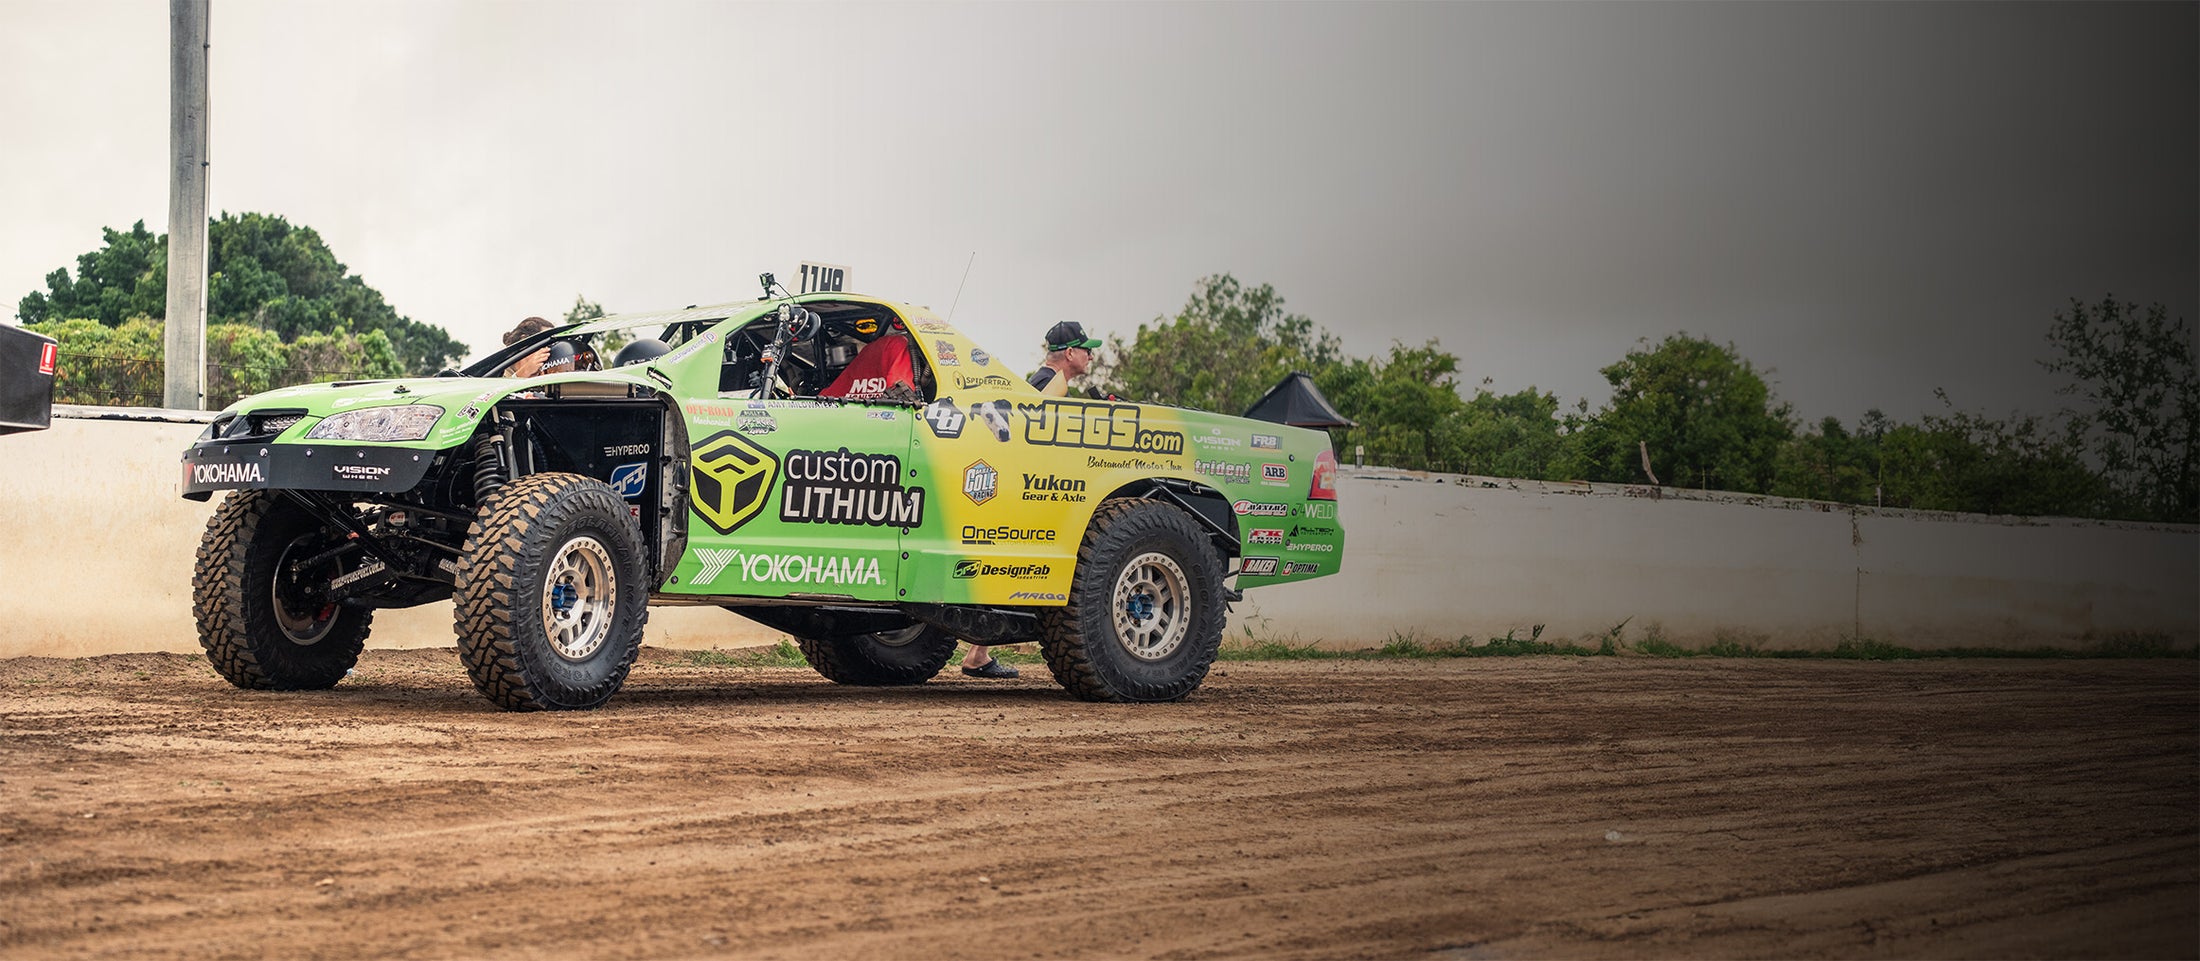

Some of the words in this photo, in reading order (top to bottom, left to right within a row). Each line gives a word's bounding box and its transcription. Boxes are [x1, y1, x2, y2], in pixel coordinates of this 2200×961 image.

[850, 378, 887, 393] MSD
[966, 376, 1012, 387] SPIDERTRAX
[686, 404, 734, 417] OFF-ROAD
[1019, 401, 1183, 454] JEGS.com
[1193, 435, 1241, 447] VISION
[611, 444, 650, 456] HYPERCO
[334, 465, 391, 475] VISION
[787, 452, 897, 484] custom
[1132, 459, 1164, 471] Motor
[1166, 459, 1182, 471] Inn
[1195, 459, 1251, 477] trident
[193, 463, 262, 483] YOKOHAMA
[1265, 467, 1286, 478] ARB
[964, 469, 997, 492] COLE
[1022, 474, 1086, 492] Yukon
[1022, 492, 1049, 501] Gear
[1051, 493, 1061, 501] &
[1061, 493, 1086, 502] Axle
[783, 486, 921, 523] LITHIUM
[962, 526, 1056, 541] OneSource
[1293, 543, 1333, 552] HYPERCO
[739, 554, 881, 584] YOKOHAMA
[981, 564, 1051, 578] DesignFab
[1246, 560, 1276, 572] BAKER
[1292, 563, 1319, 574] OPTIMA
